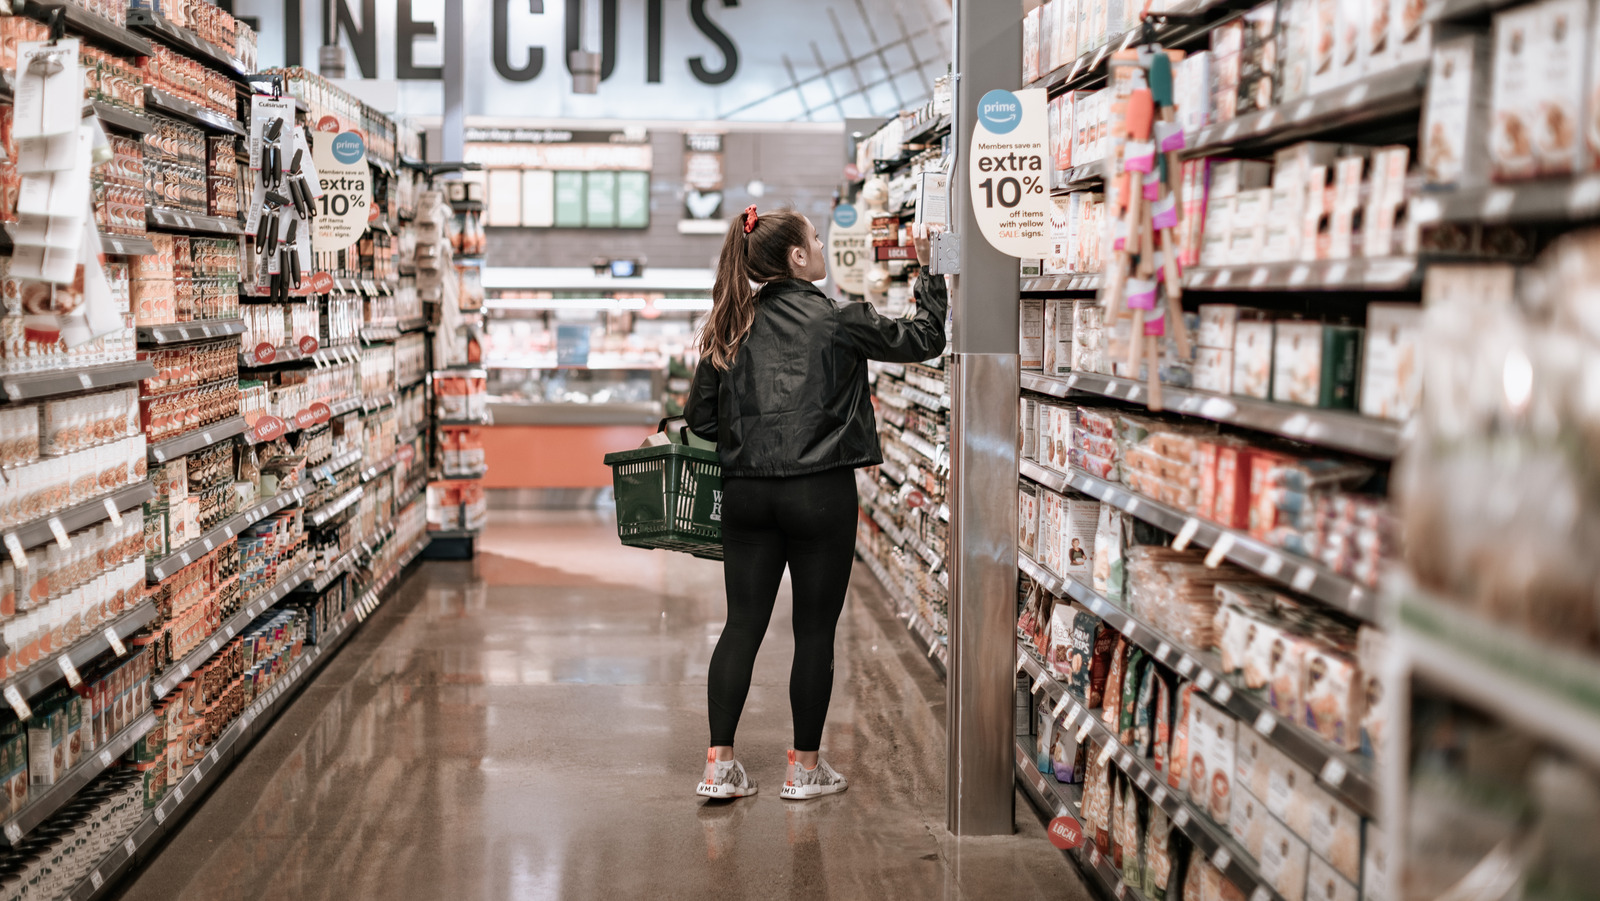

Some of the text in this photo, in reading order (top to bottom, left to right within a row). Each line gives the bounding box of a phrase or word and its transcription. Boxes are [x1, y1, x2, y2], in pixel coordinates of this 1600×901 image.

[216, 0, 446, 80] INE
[258, 101, 288, 109] Cuisinart
[984, 101, 1016, 115] prime
[336, 140, 359, 150] prime
[978, 152, 1042, 172] extra
[319, 177, 364, 191] extra
[978, 176, 1043, 208] 10%
[318, 194, 365, 216] 10%
[1009, 210, 1021, 218] off
[999, 220, 1044, 229] with yellow
[888, 247, 908, 258] LOCAL
[313, 277, 331, 290] LOCAL
[258, 346, 274, 359] LOCAL
[298, 413, 313, 424] LOCAL
[314, 407, 328, 418] OCAL
[258, 421, 279, 436] LOCAL
[1052, 822, 1077, 843] LOCAL
